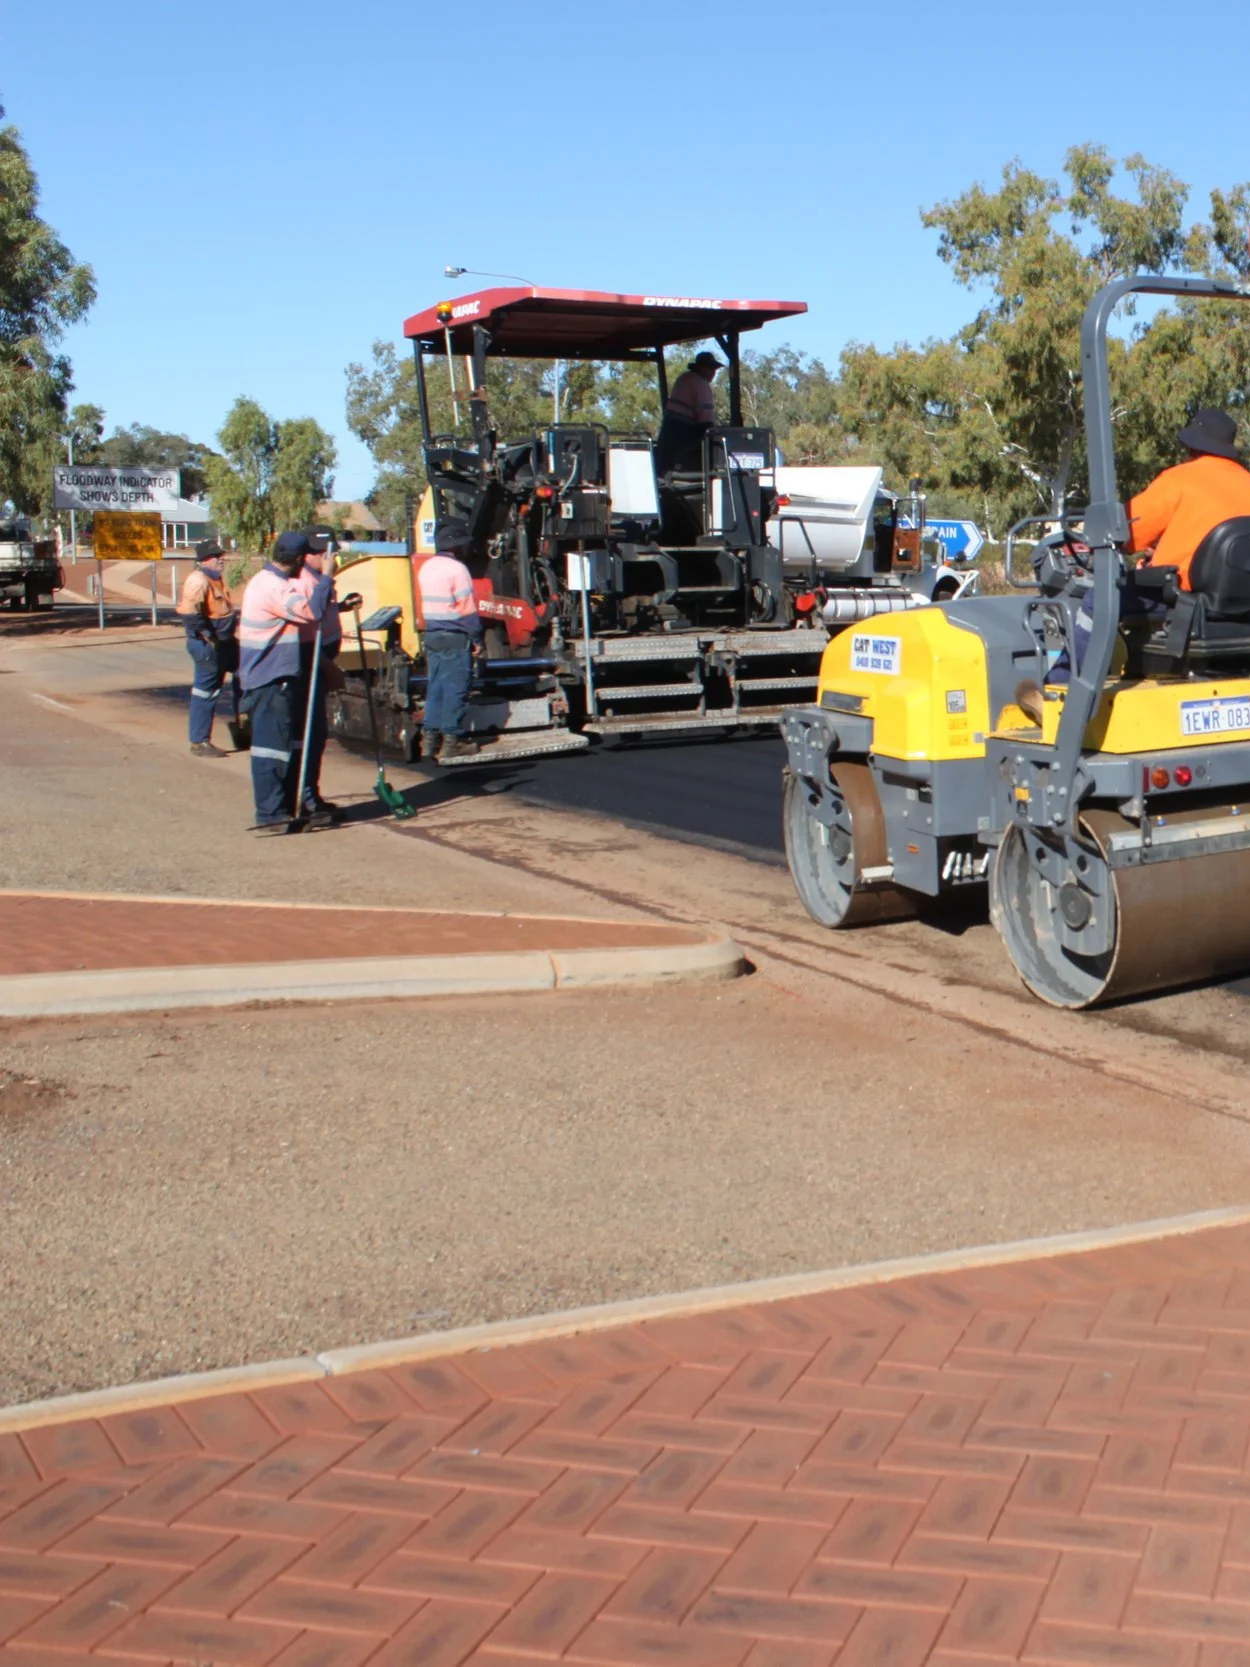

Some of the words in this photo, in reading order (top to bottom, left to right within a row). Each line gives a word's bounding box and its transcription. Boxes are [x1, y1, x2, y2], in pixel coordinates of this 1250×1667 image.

[643, 296, 723, 309] DYNAPAC
[60, 474, 117, 486] FLOODWAY
[119, 477, 172, 488] INDICATOR
[80, 491, 119, 502] SHOWS
[121, 492, 154, 503] DEPTH
[854, 637, 870, 652] CAT
[872, 639, 897, 655] WEST
[1185, 710, 1221, 732] 1EWR
